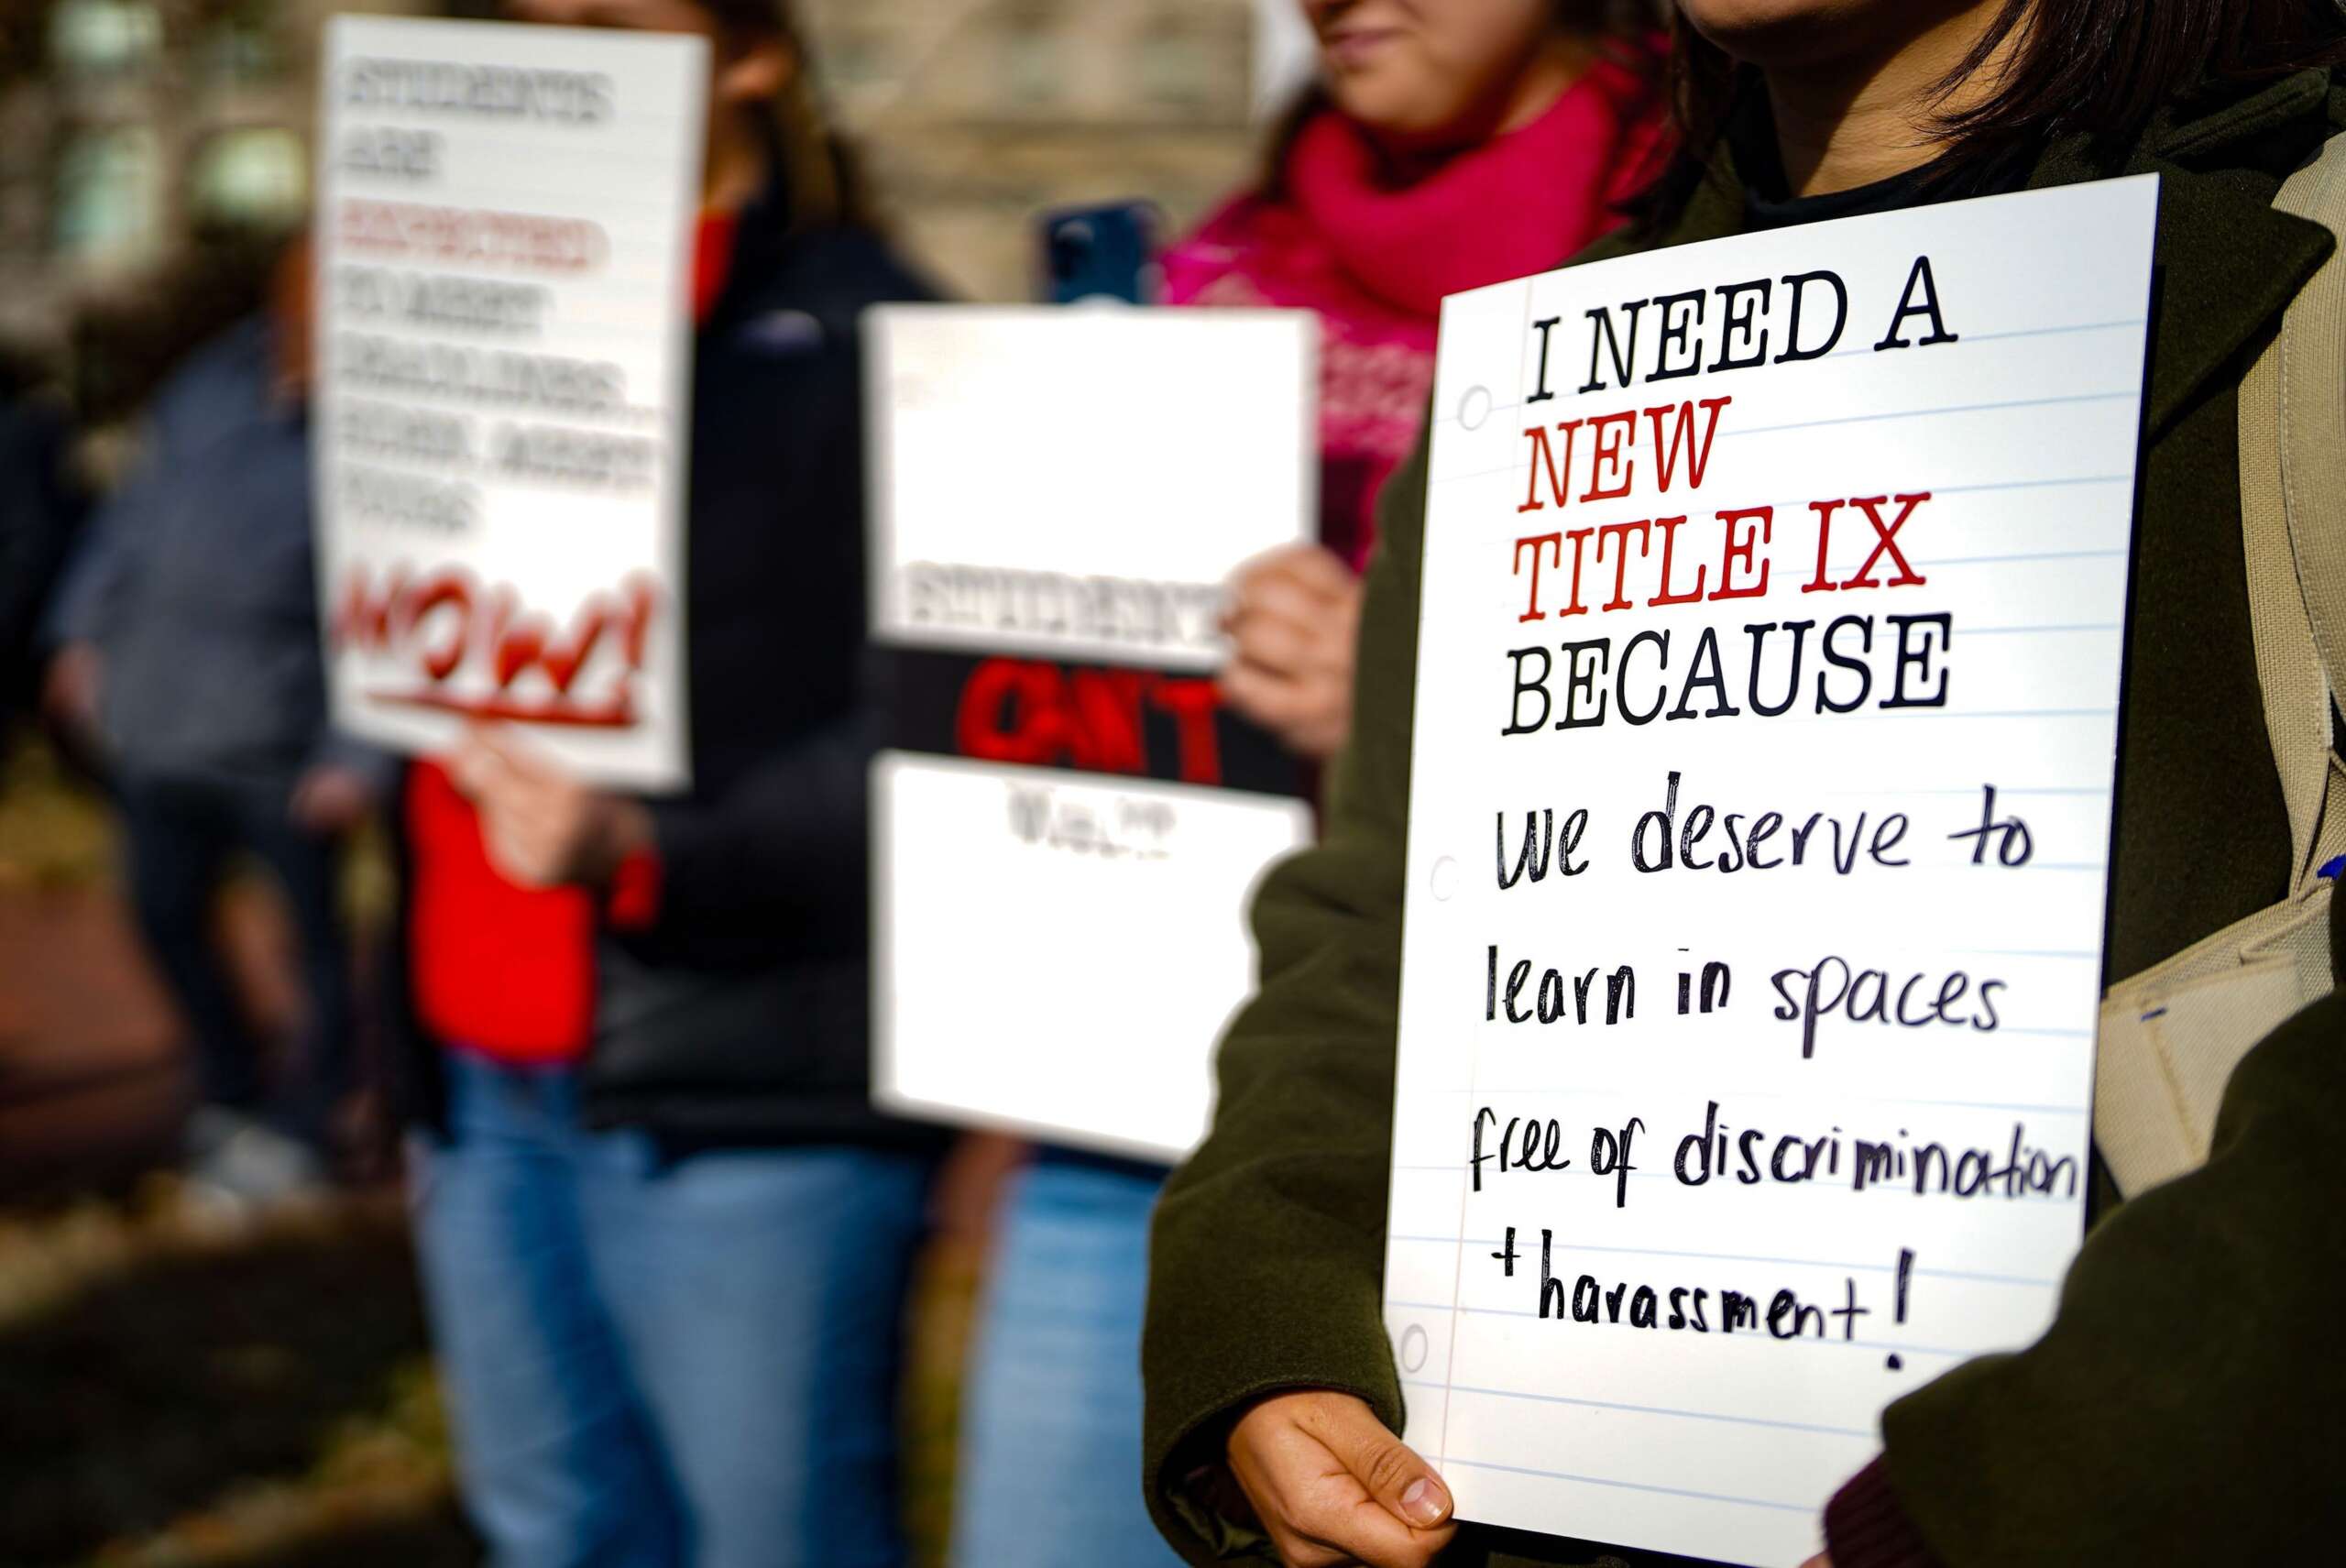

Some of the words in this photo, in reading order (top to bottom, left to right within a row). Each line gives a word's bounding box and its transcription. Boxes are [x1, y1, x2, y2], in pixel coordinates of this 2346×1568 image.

[1528, 315, 1561, 403] I
[1578, 270, 1848, 394] NEED
[1874, 255, 1958, 351] A
[1518, 395, 1732, 512] NEW
[1514, 505, 1773, 623] TITLE
[1802, 491, 1932, 594] IX
[1501, 612, 1952, 736] BECAUSE
[1631, 771, 1911, 875] deserve
[1948, 784, 2034, 867] to
[1486, 945, 1636, 1025] learn
[1676, 948, 1731, 1015] in
[1770, 956, 2008, 1059] spaces
[1470, 1107, 1571, 1192] free
[1591, 1117, 1646, 1208] of
[1673, 1100, 2078, 1199] discrimination
[1491, 1227, 1521, 1277] +
